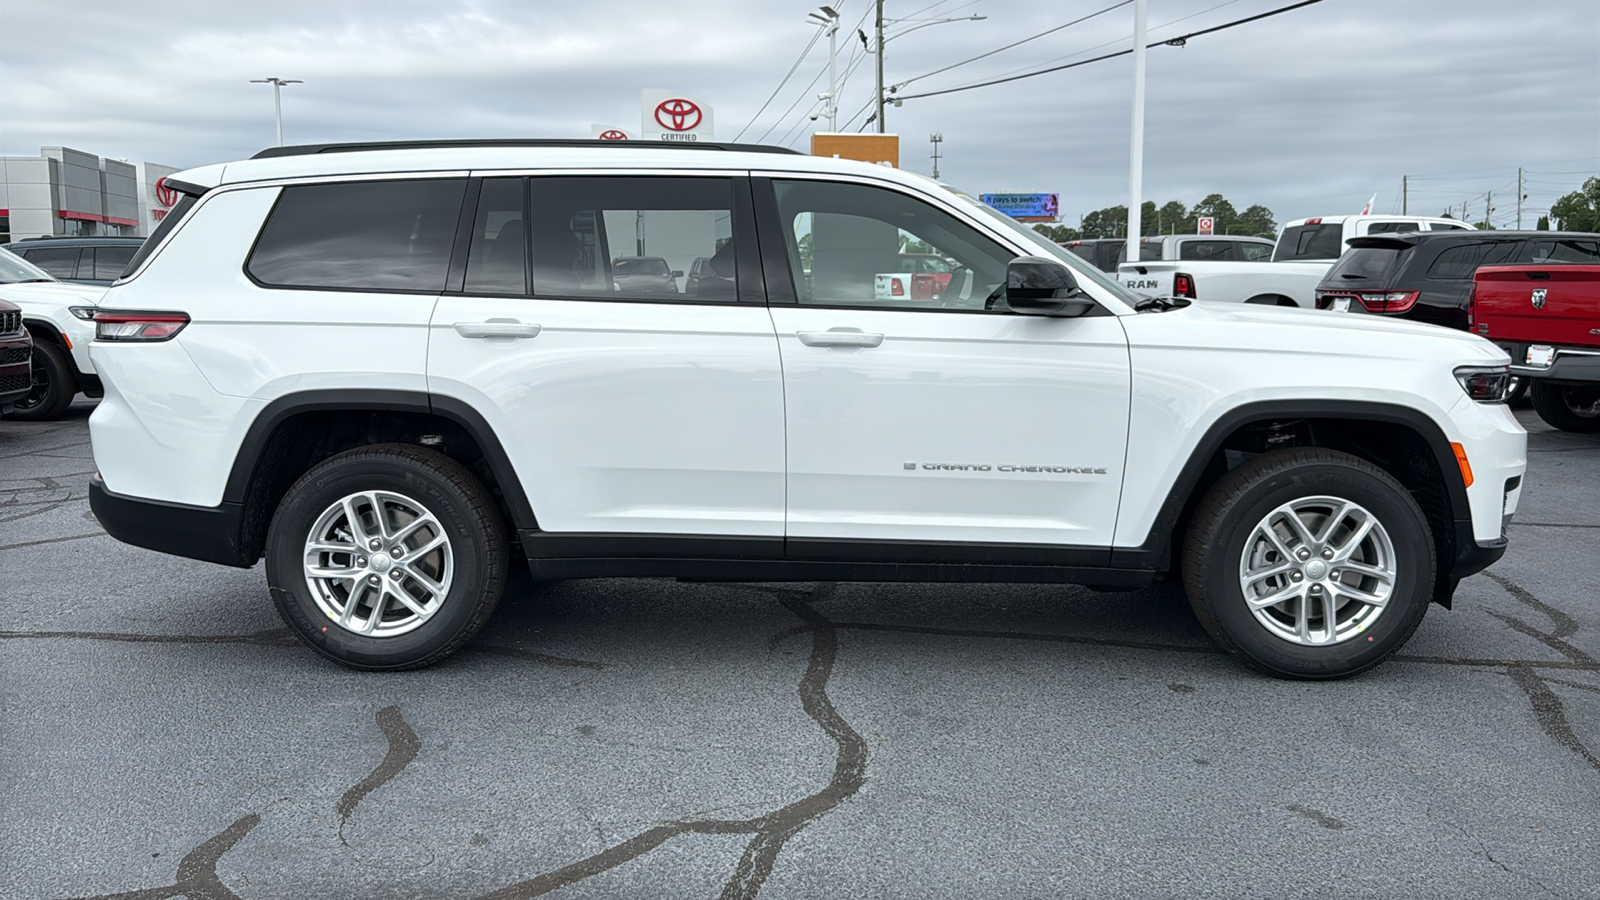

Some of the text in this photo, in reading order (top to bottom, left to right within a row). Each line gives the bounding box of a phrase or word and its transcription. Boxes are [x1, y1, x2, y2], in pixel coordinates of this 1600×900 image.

[661, 132, 697, 142] CERTIFIED
[993, 197, 1010, 205] pays
[1127, 280, 1158, 289] RAM
[922, 463, 1108, 475] GRAND CHEROKEE
